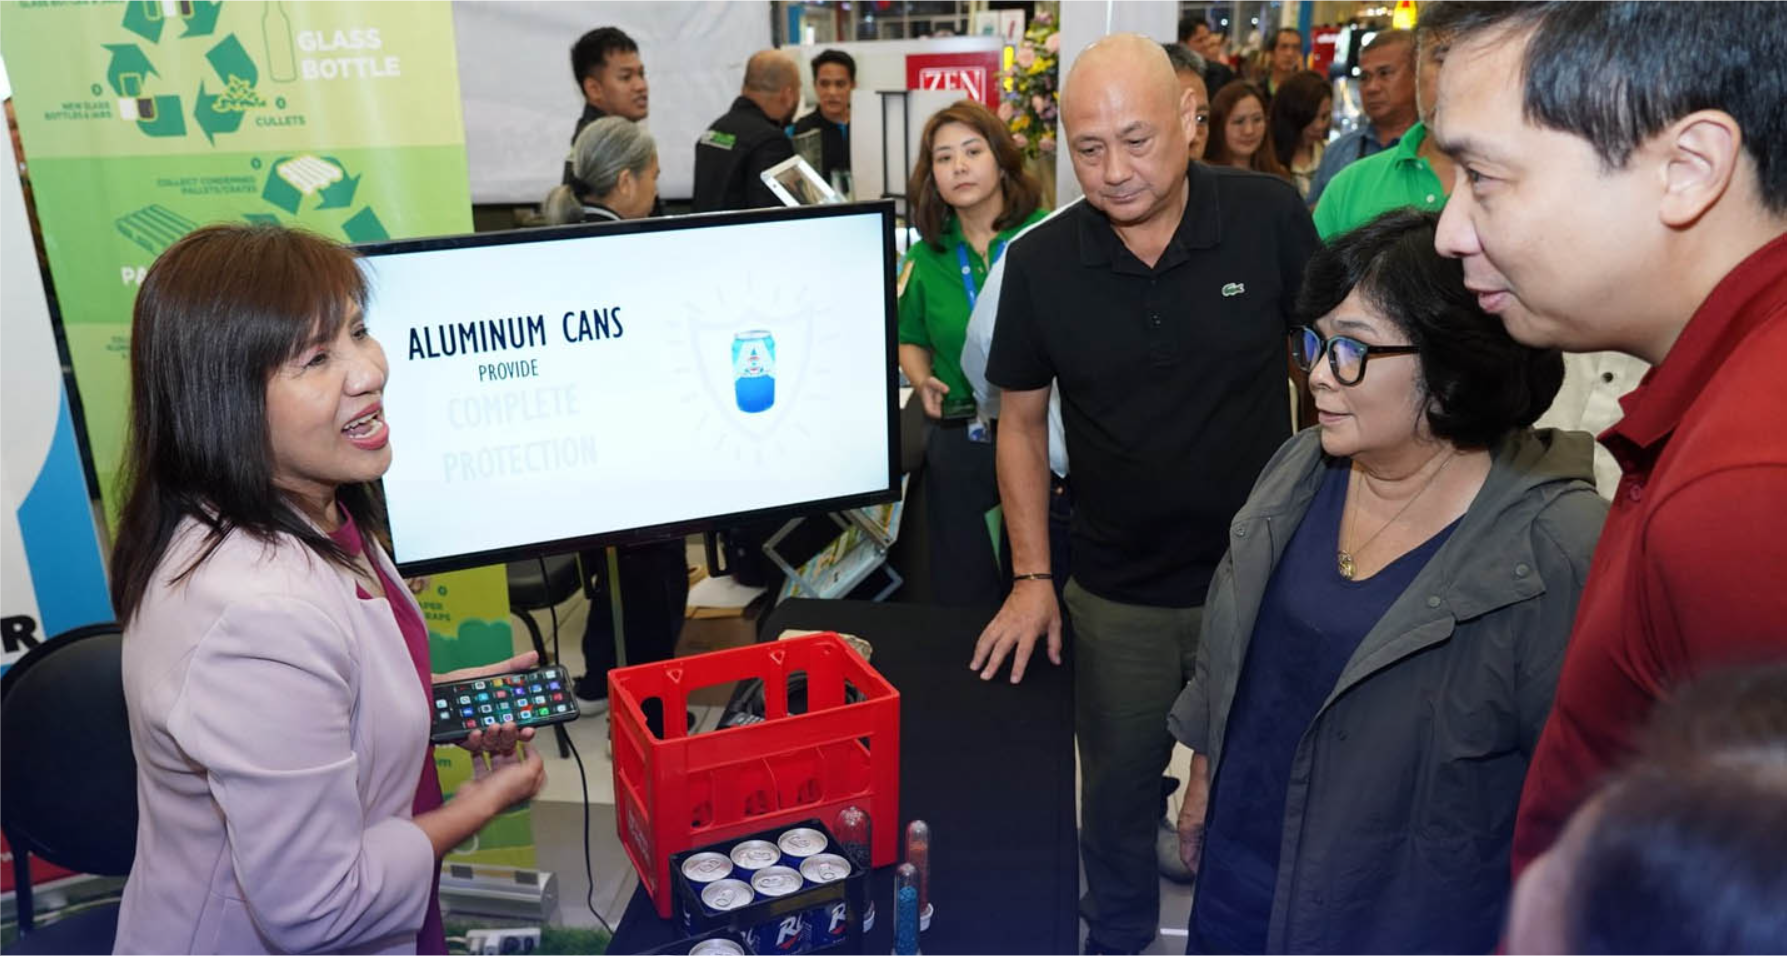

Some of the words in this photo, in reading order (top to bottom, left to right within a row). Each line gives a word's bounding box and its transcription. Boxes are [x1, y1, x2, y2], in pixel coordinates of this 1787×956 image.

[298, 29, 381, 51] GLASS
[302, 56, 400, 80] BOTTLE
[923, 69, 980, 101] ZEN
[255, 115, 306, 126] CULLETS
[409, 314, 546, 361] ALUMINUM
[562, 306, 624, 343] CANS
[478, 359, 539, 382] PROVIDE
[448, 383, 581, 430] COMPLETE
[443, 434, 598, 484] PROTECTION
